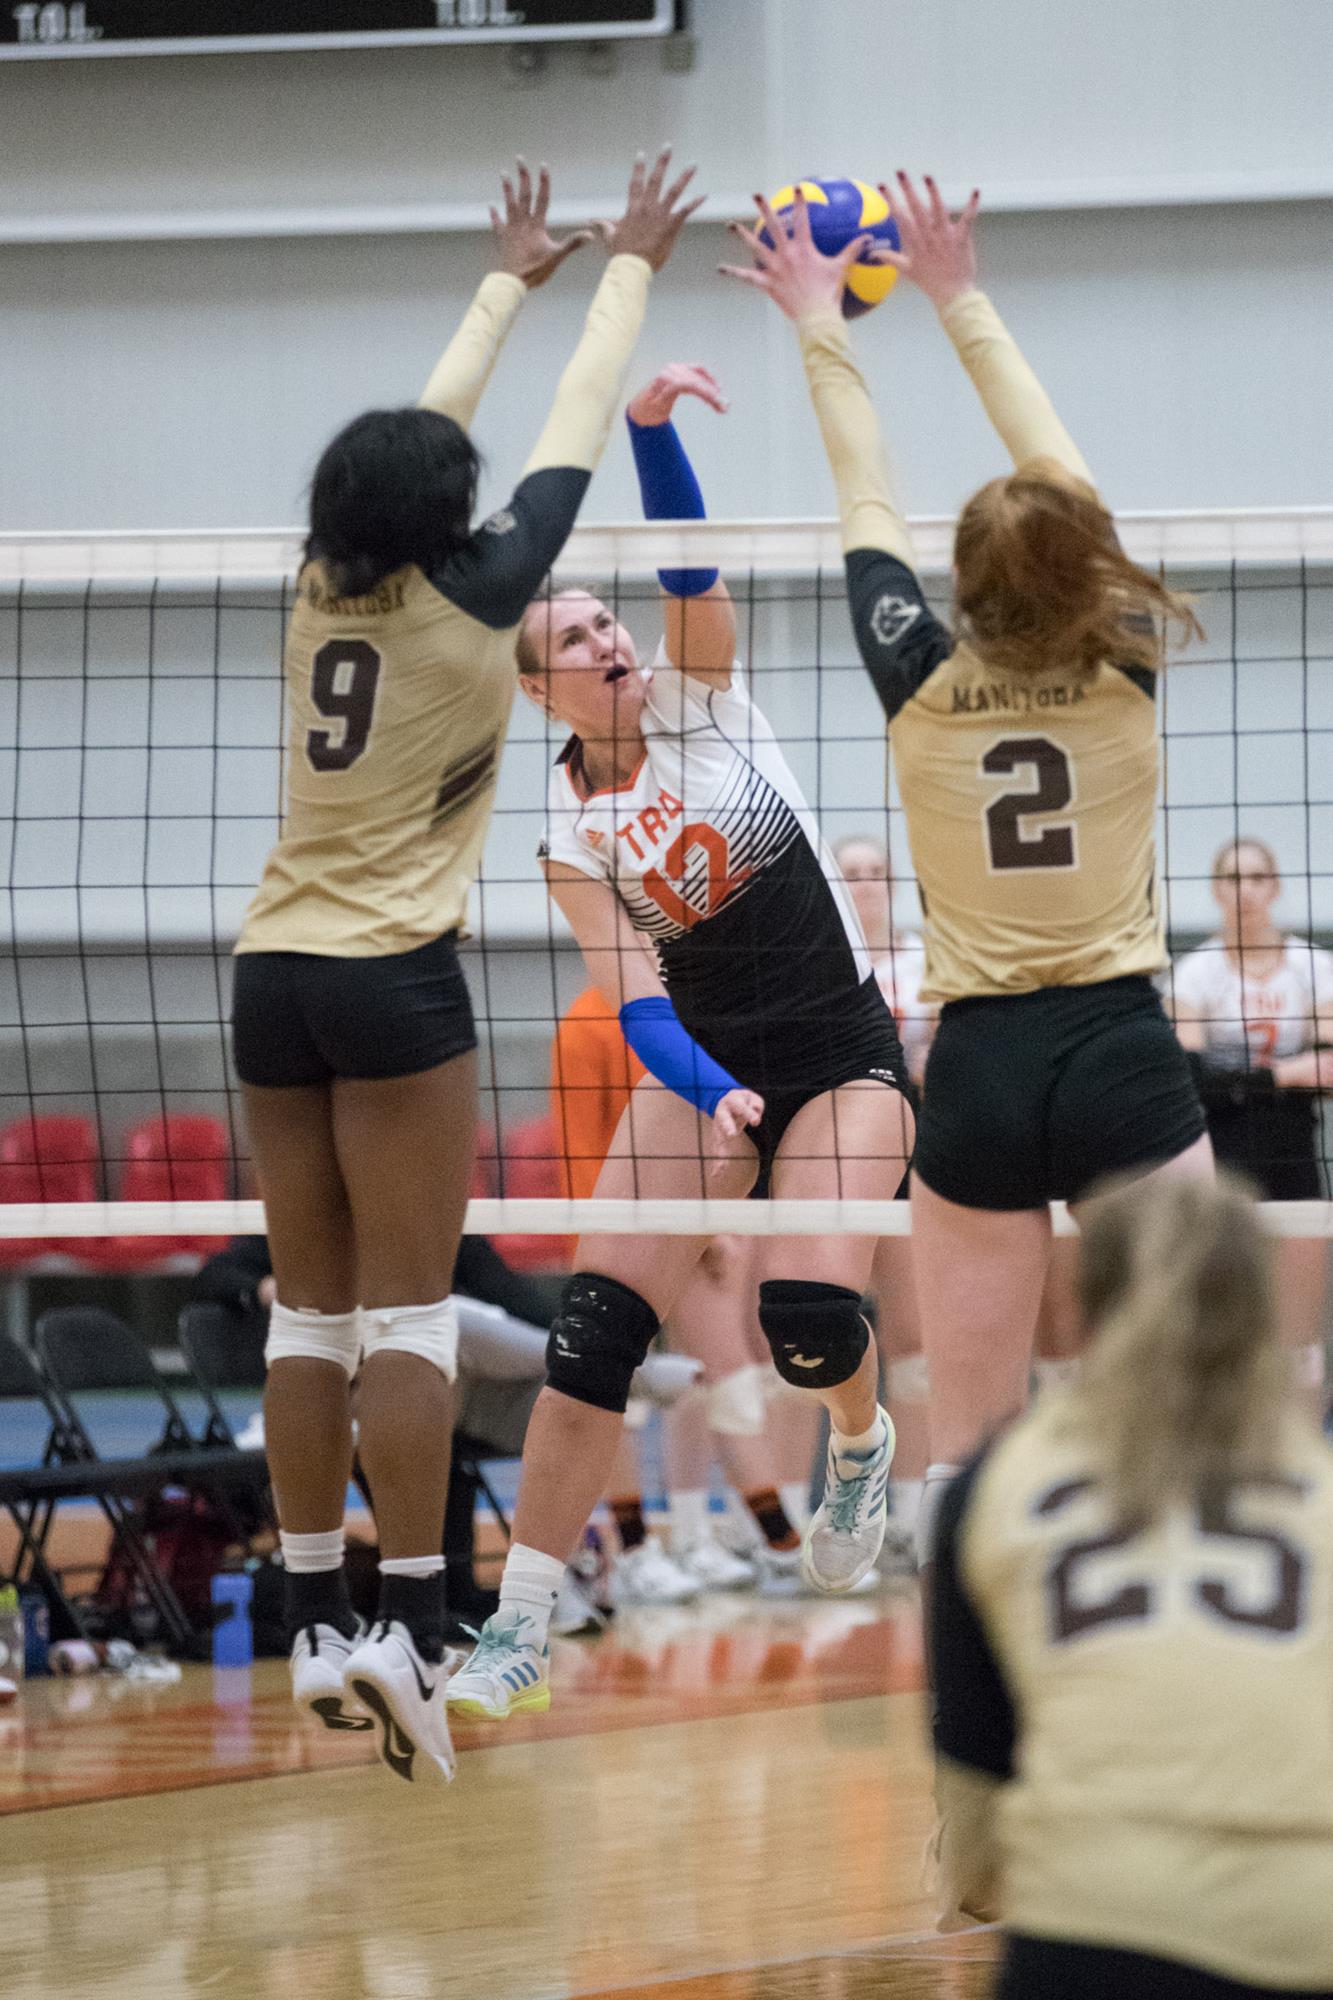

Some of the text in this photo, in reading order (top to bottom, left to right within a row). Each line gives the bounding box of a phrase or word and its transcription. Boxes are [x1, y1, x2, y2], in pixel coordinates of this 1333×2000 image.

[306, 638, 381, 773] 9
[952, 683, 1084, 713] MANITOBA
[981, 736, 1076, 871] 2
[1033, 1472, 1314, 1645] 25
